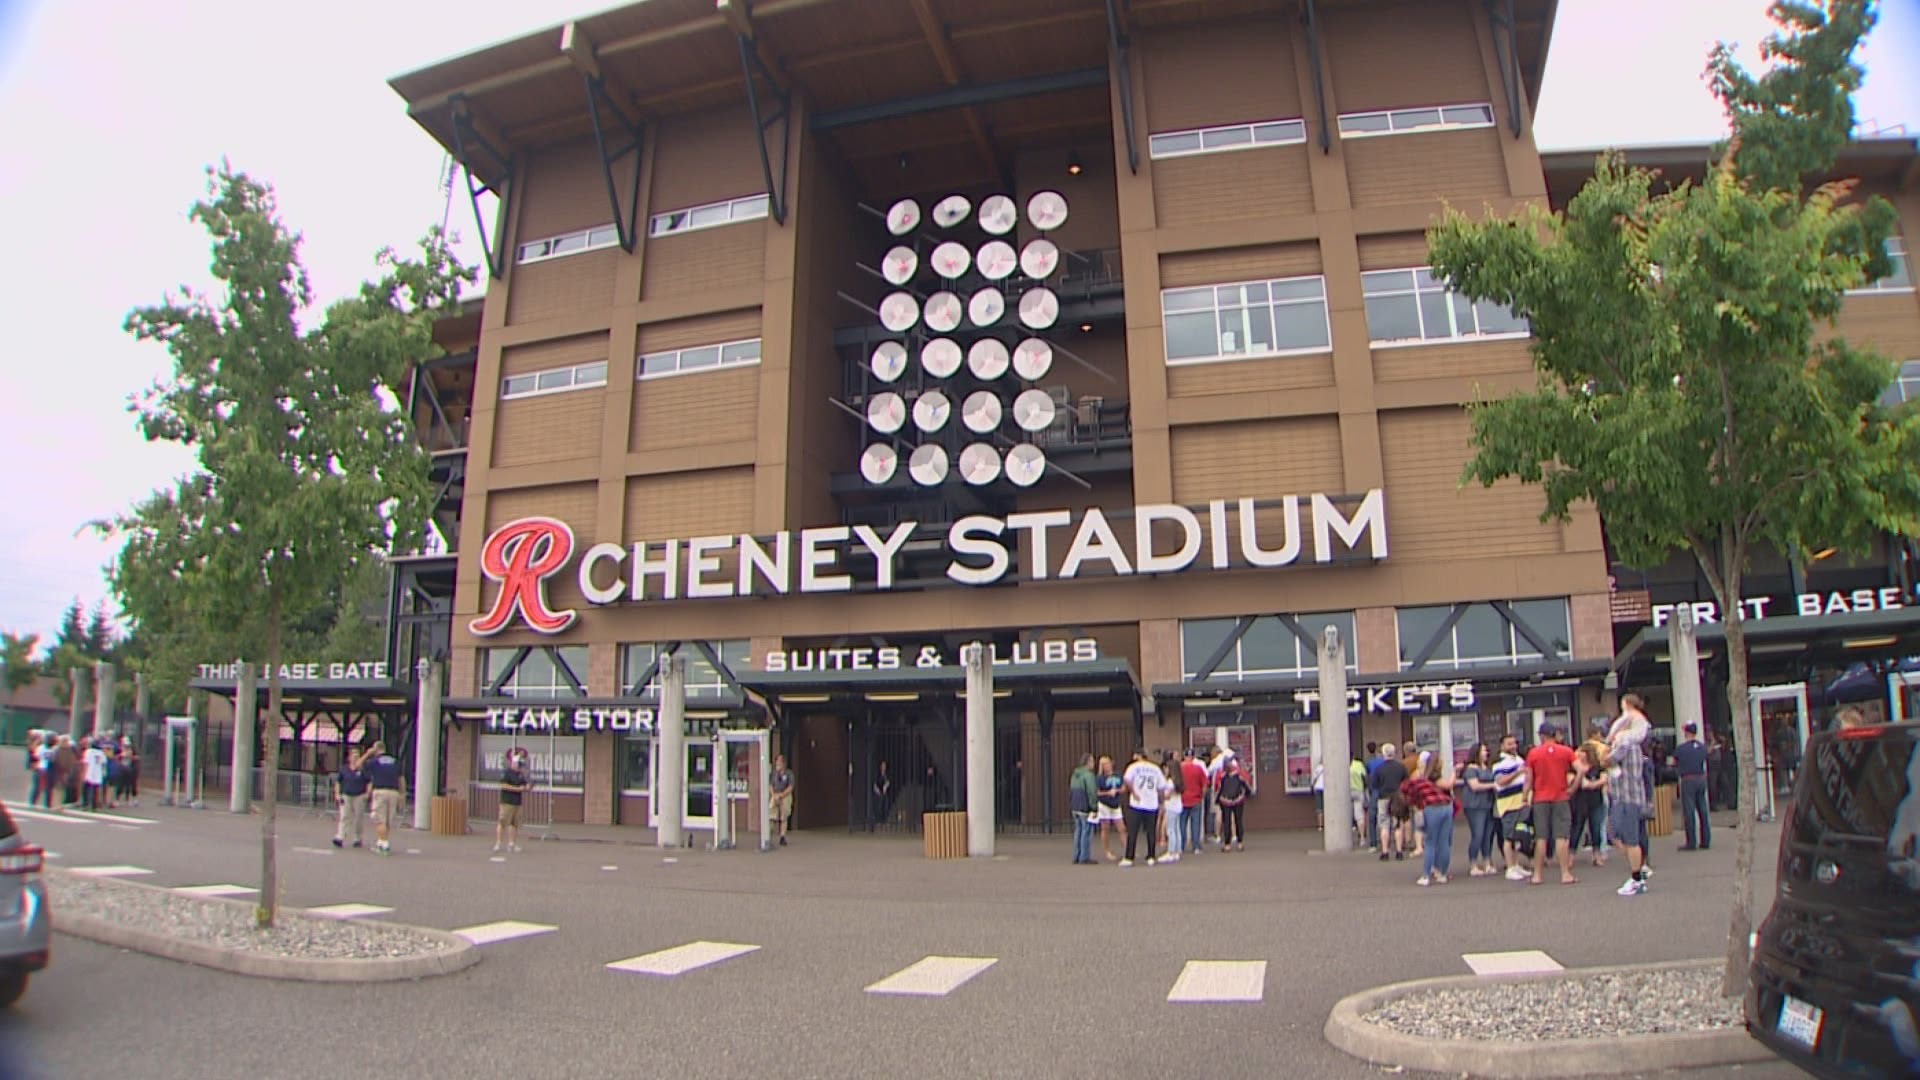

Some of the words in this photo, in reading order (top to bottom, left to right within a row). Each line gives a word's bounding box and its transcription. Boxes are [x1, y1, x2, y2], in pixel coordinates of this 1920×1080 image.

[578, 521, 918, 604] CHENEY
[947, 488, 1388, 585] STADIUM
[1652, 597, 1770, 627] FRT
[1798, 587, 1904, 616] BASE
[199, 663, 241, 680] THIR
[329, 662, 388, 679] GATE
[766, 647, 901, 672] SUITES
[916, 646, 943, 668] &
[1294, 683, 1475, 716] TCKETS
[488, 708, 561, 730] TEAM
[573, 708, 661, 731] STOR
[726, 778, 748, 793] 502
[1138, 775, 1154, 789] 75
